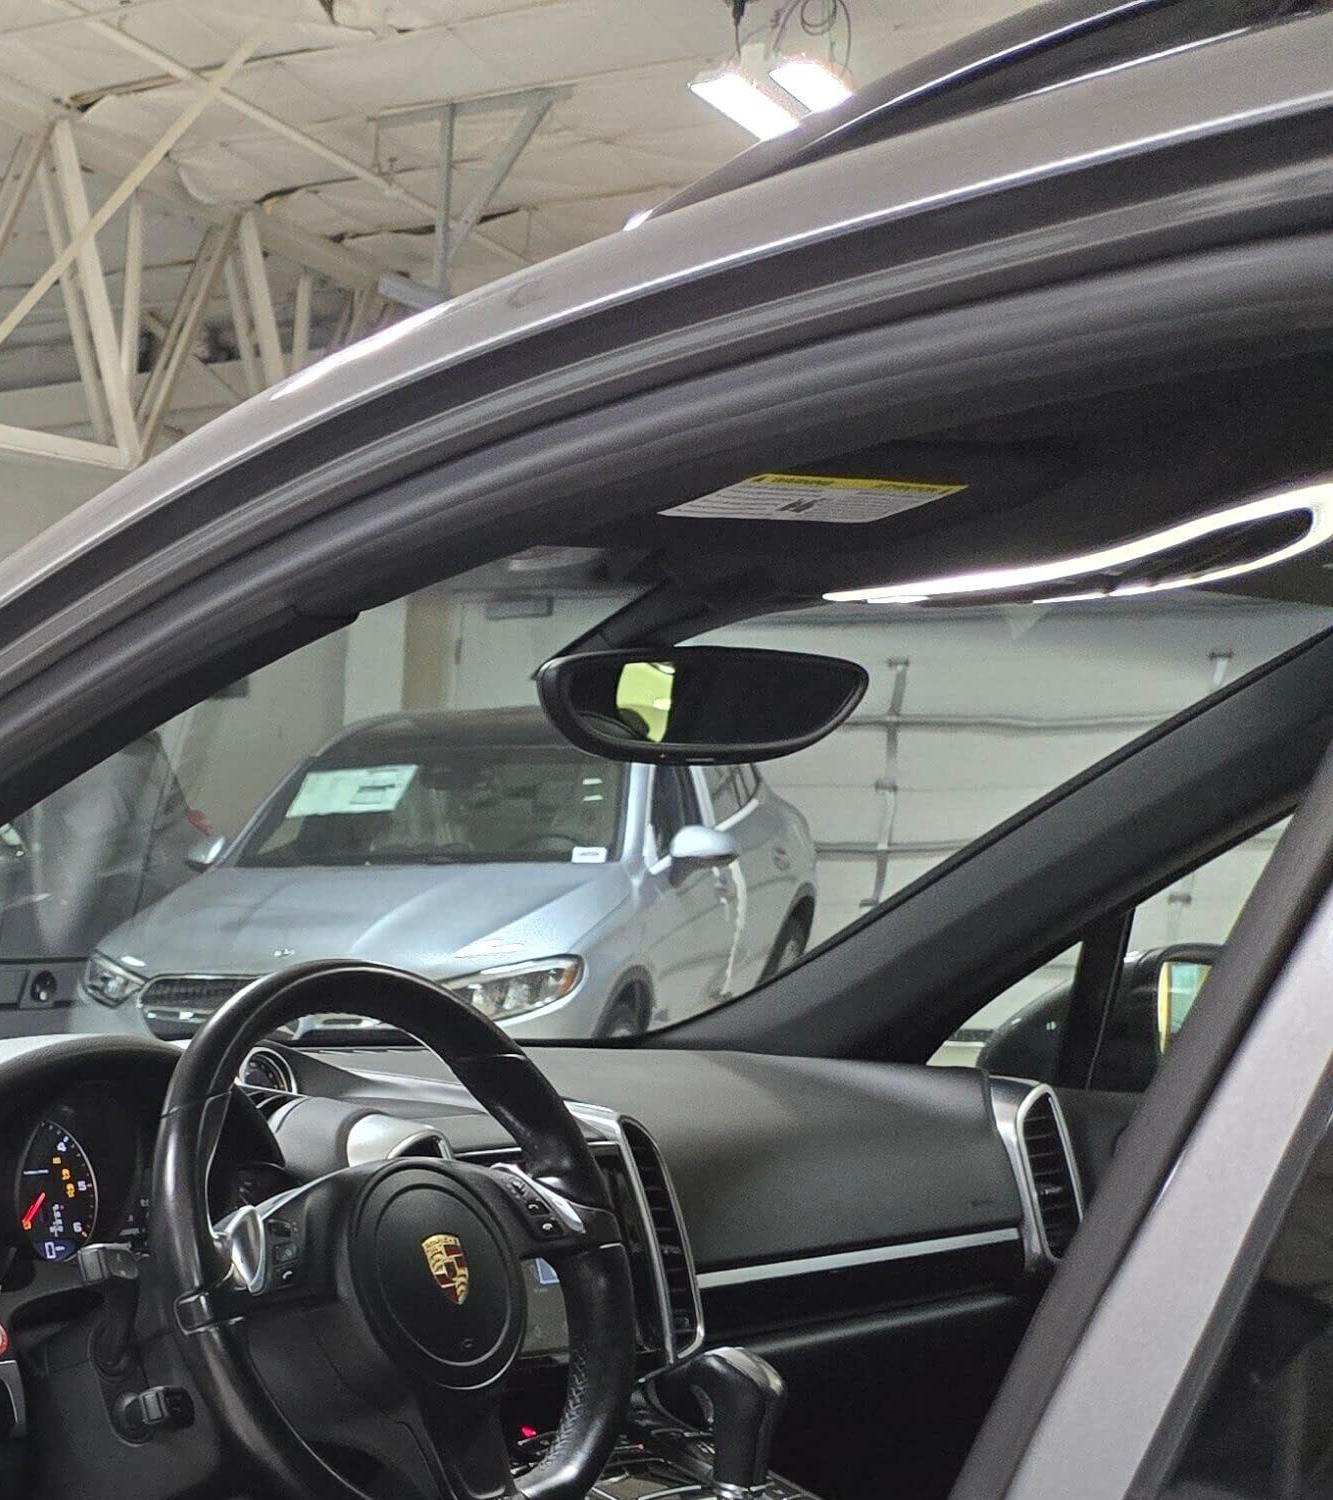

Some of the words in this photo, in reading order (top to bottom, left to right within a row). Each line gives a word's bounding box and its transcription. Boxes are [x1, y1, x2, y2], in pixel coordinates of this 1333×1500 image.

[57, 1141, 67, 1152] 4
[77, 1181, 87, 1191] 5
[73, 1222, 82, 1232] 6
